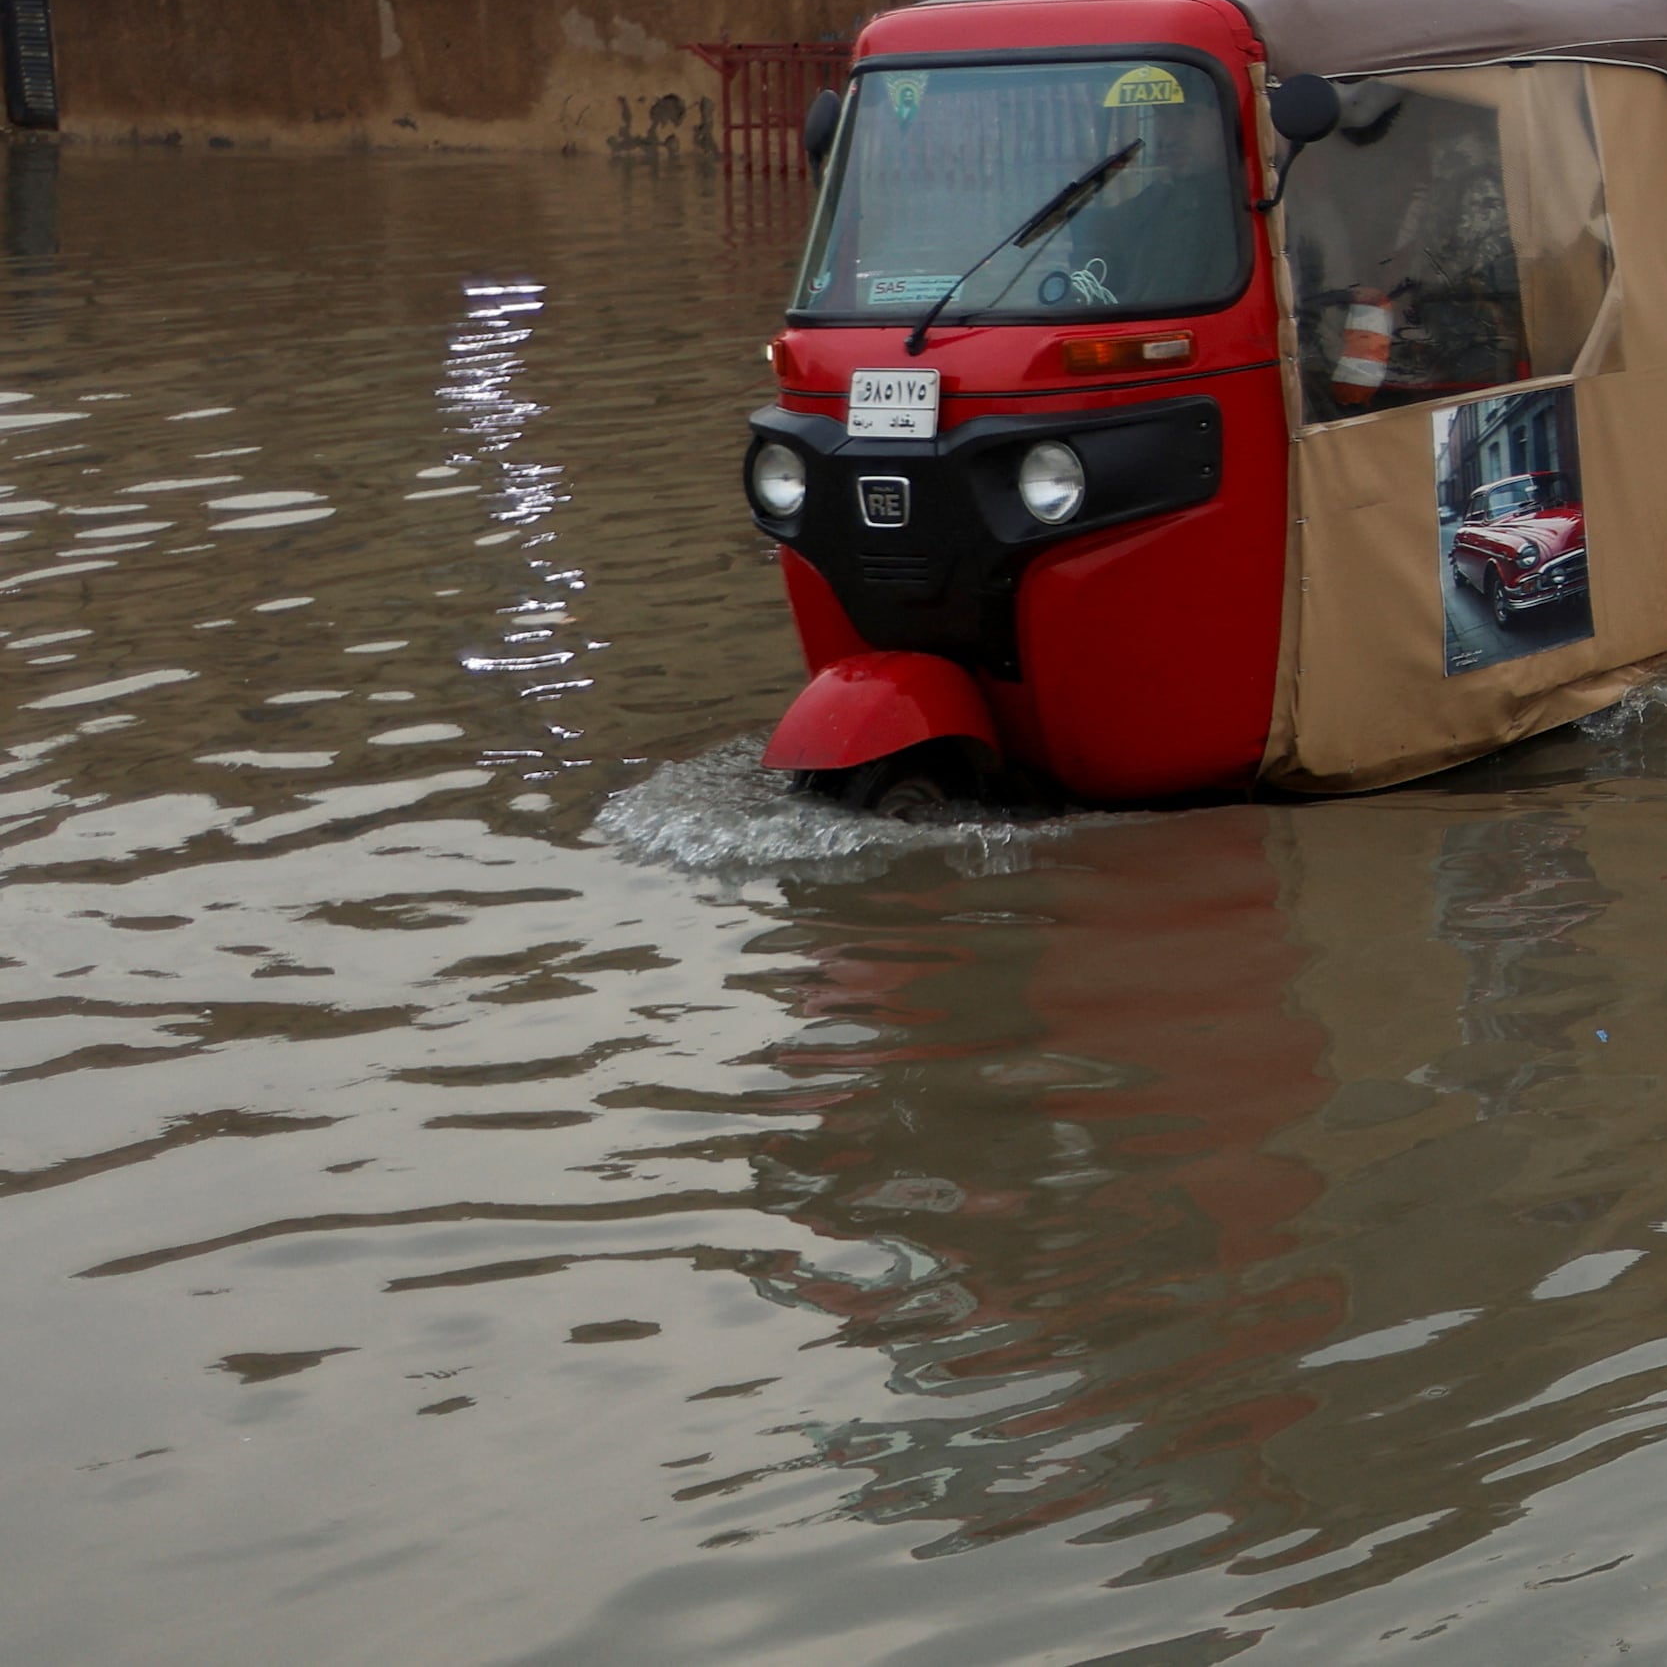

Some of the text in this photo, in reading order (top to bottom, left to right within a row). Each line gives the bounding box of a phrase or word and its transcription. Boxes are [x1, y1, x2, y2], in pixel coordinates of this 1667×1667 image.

[1122, 82, 1171, 102] TAXI
[875, 280, 906, 294] SAS
[889, 413, 916, 433] بغداد
[868, 494, 901, 516] RE
